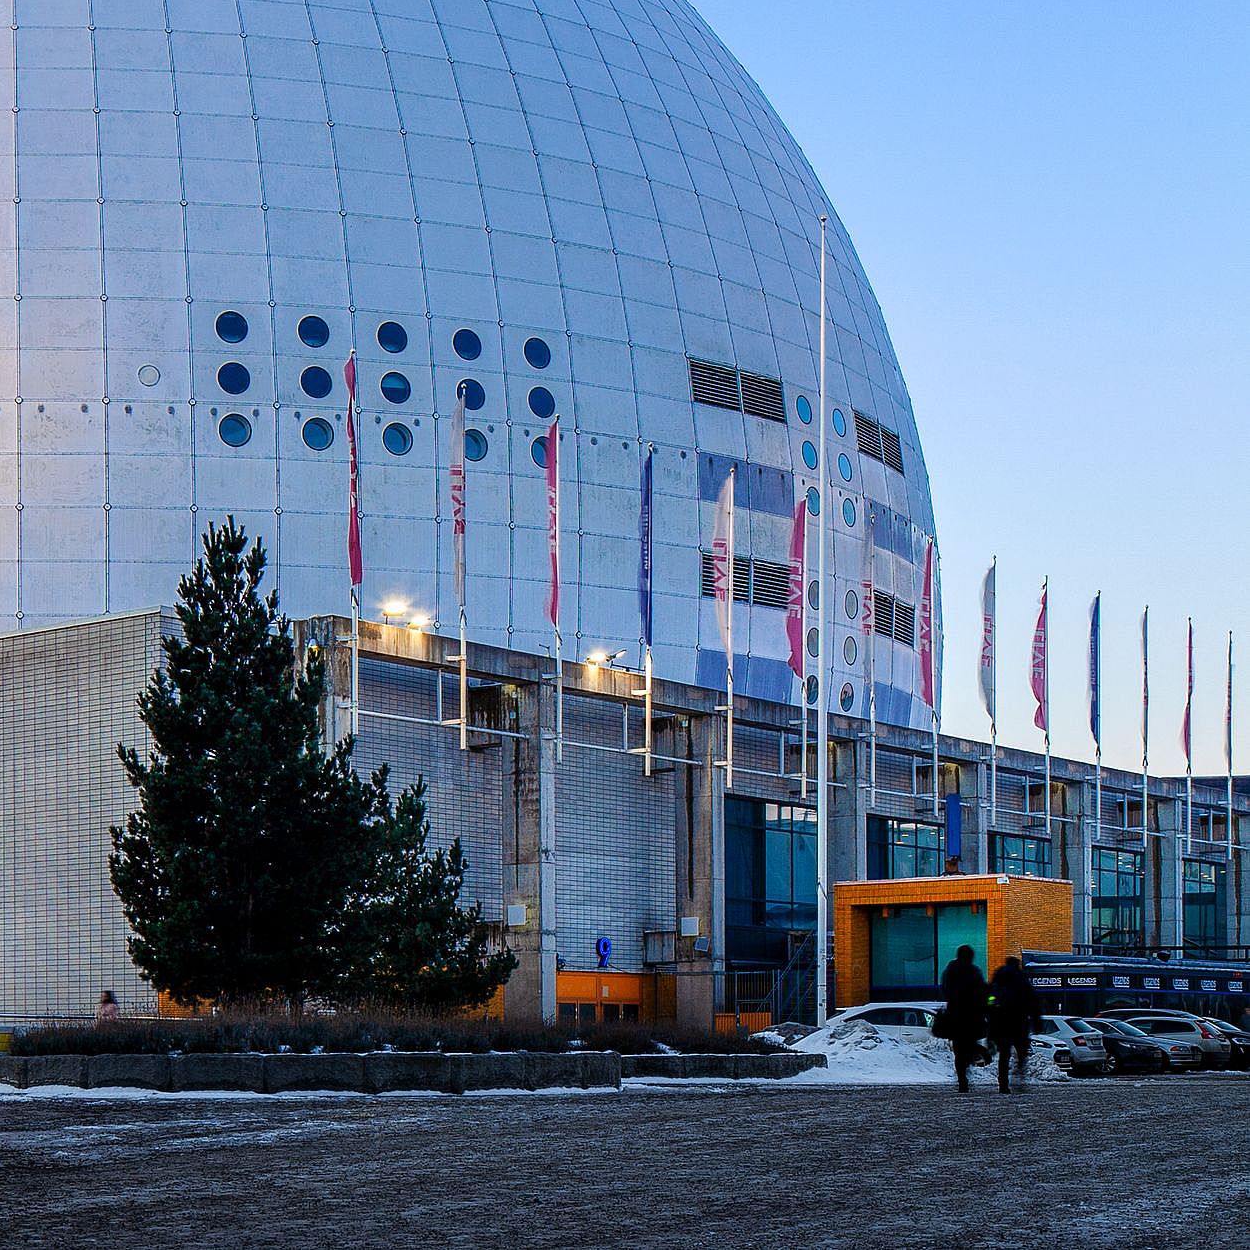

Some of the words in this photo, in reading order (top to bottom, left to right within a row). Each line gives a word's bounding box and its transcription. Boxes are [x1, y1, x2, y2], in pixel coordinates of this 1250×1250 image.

[1067, 977, 1097, 986] LEGENDS
[1112, 976, 1130, 988] LEGENDS
[1143, 977, 1160, 989] LEGENDS
